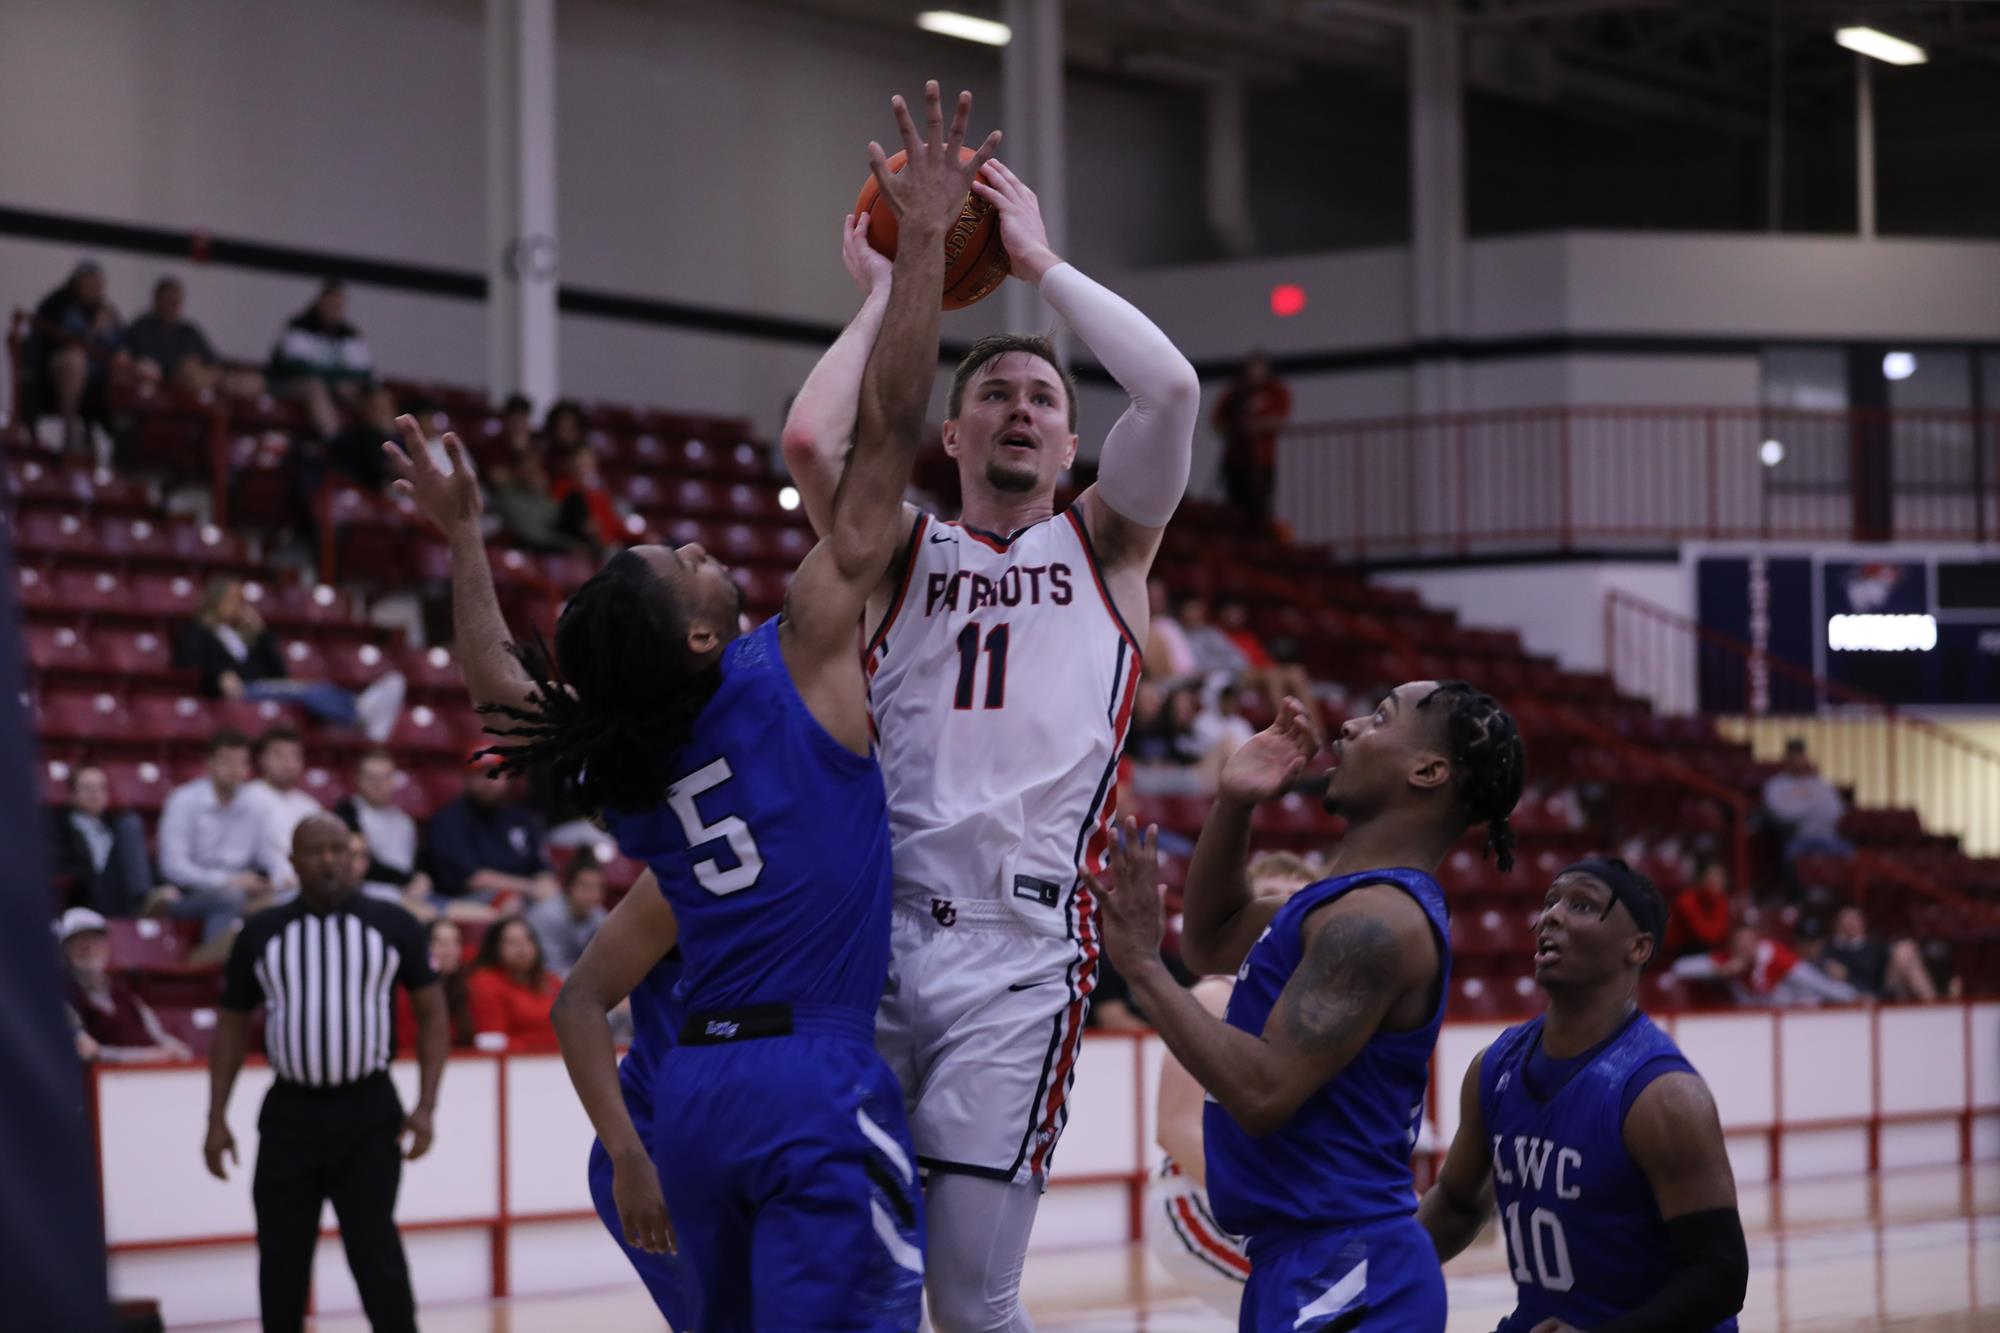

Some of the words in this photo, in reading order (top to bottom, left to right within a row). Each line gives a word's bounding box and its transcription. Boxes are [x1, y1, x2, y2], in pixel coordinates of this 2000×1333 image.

[925, 562, 1073, 617] PATRIOTS
[954, 621, 1010, 710] 11
[666, 756, 764, 897] 5
[1493, 1134, 1582, 1201] LWC
[1505, 1201, 1575, 1293] 10
